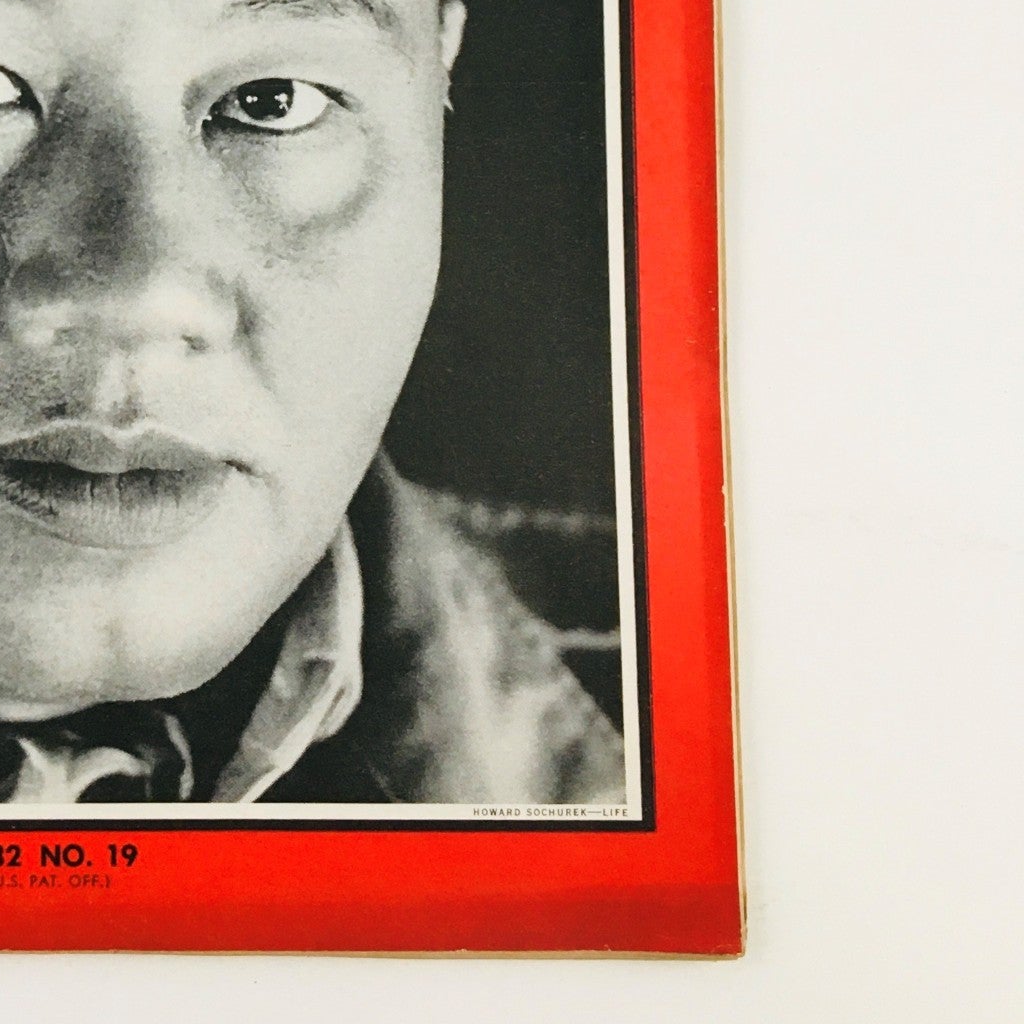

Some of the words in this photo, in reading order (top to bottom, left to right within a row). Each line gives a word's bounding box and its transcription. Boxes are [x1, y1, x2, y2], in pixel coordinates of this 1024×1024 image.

[473, 808, 521, 816] HOWARD
[40, 843, 93, 868] NO.
[107, 843, 138, 868] 19
[29, 874, 62, 889] PAT.
[68, 874, 111, 889] OFF.)
